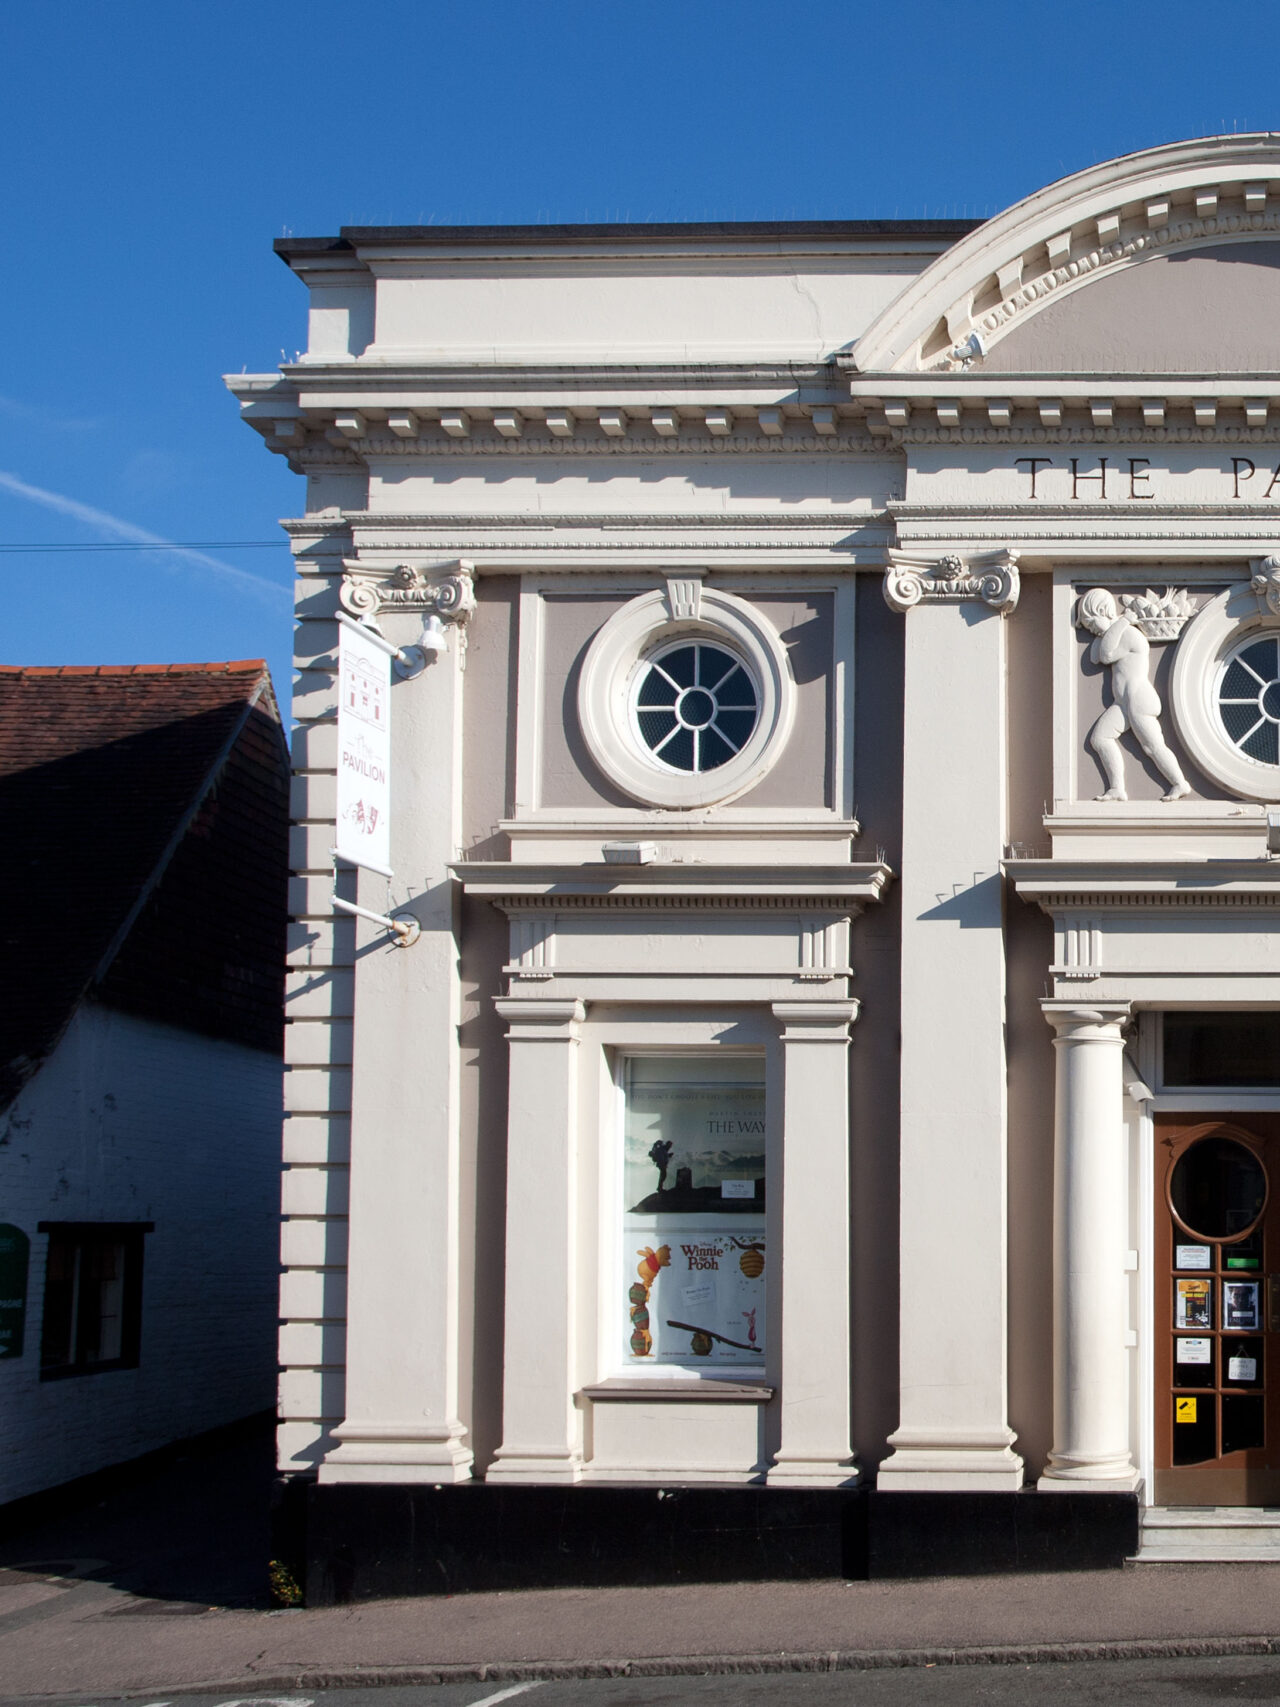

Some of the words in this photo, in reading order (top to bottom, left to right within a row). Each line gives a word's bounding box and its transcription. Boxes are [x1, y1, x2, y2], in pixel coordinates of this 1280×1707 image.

[1015, 457, 1154, 499] THE
[343, 751, 386, 784] PAVILION
[706, 1120, 734, 1133] THE
[737, 1120, 766, 1133] WAY
[680, 1245, 724, 1257] Winnie
[688, 1257, 719, 1270] Pooh
